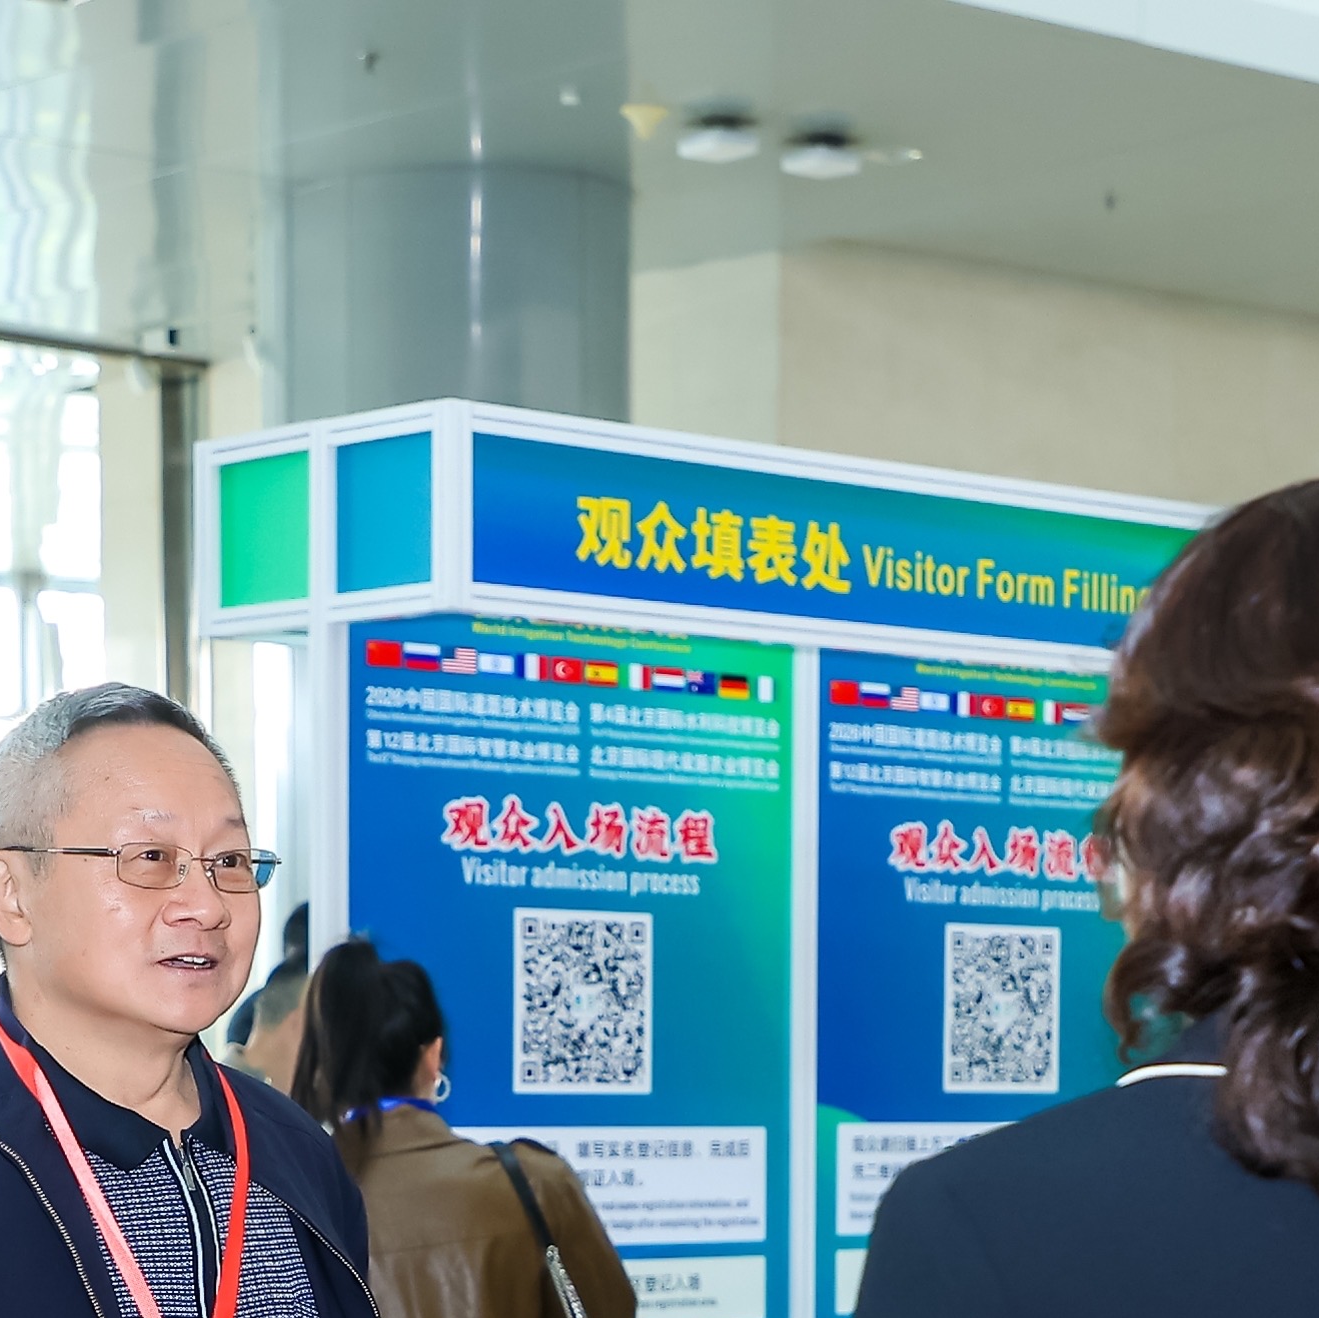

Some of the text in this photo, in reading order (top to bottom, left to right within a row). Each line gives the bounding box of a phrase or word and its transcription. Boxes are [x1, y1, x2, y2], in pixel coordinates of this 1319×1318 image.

[575, 495, 852, 595] 观众填表处
[862, 544, 970, 598] Visitor
[976, 558, 1055, 608] Form
[441, 794, 718, 865] 观众入场流程
[461, 855, 701, 897] Visitor admission process
[904, 875, 959, 903] Visitor
[959, 880, 1040, 908] admission
